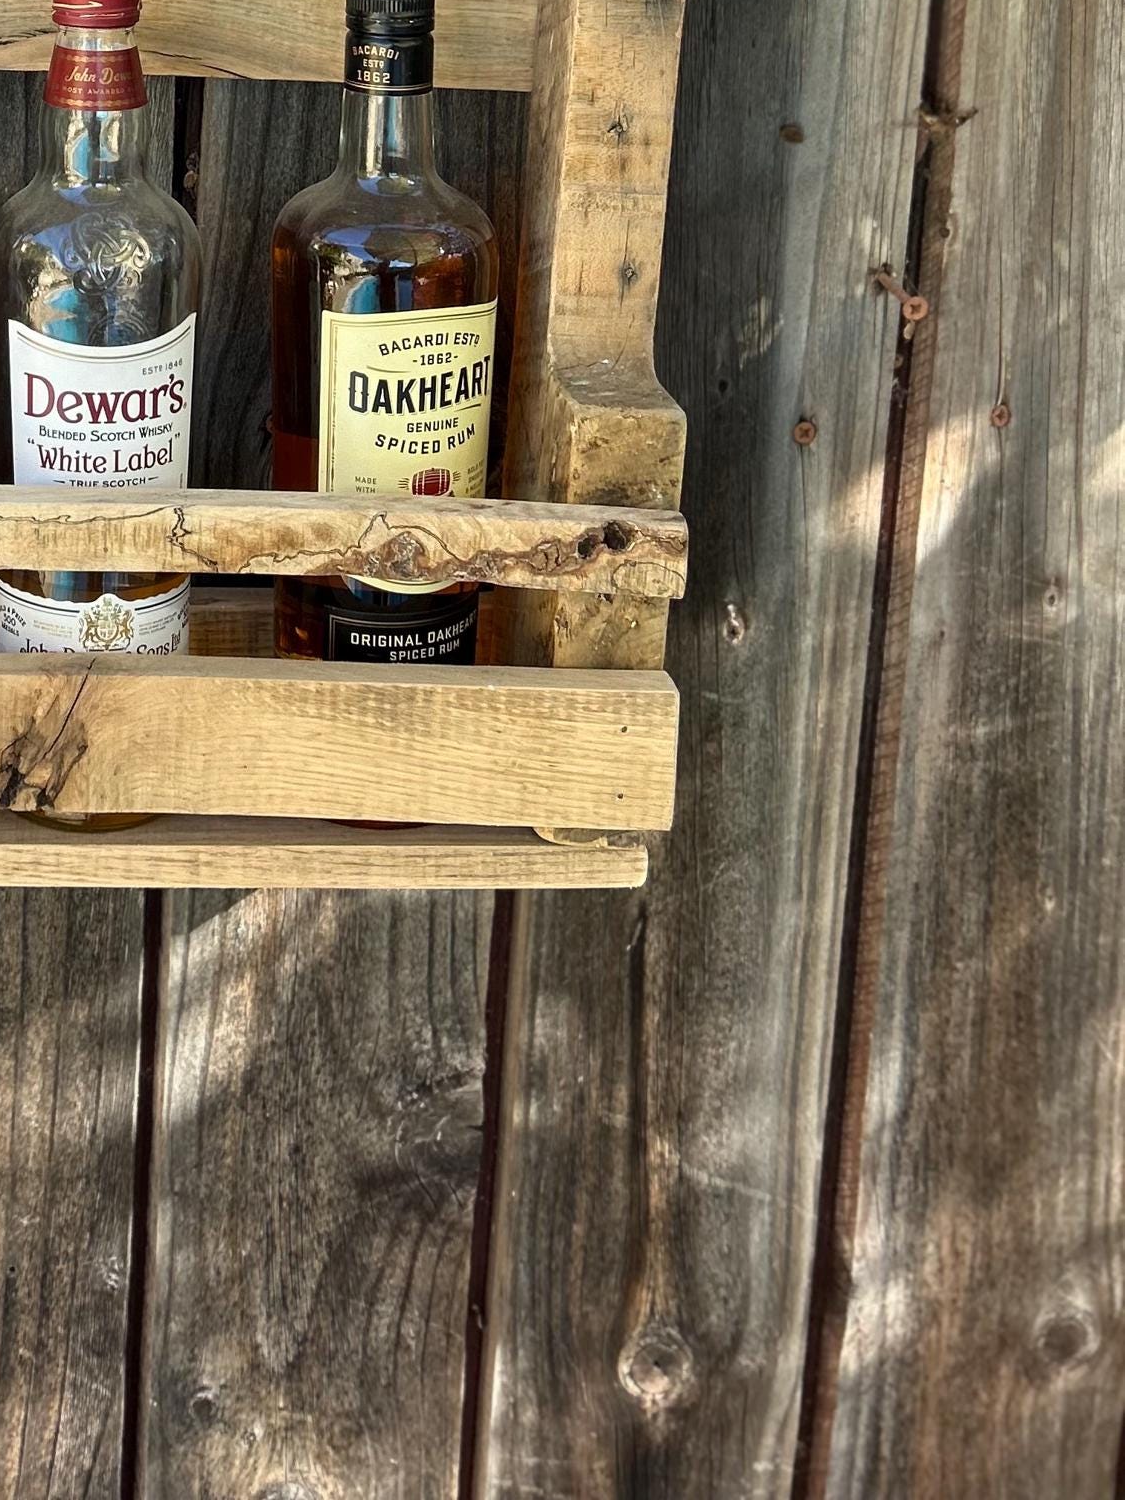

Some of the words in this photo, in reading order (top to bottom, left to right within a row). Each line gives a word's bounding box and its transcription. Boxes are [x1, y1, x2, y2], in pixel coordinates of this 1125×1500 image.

[352, 45, 400, 61] BACARDI
[64, 65, 96, 83] John
[98, 66, 132, 85] Dew
[357, 70, 391, 84] 1862
[378, 332, 449, 357] BACARDI
[165, 357, 183, 371] 1846
[348, 355, 491, 415] OAKHEART
[23, 372, 185, 425] Dewar's
[406, 417, 460, 434] GENUINE
[375, 434, 440, 455] SPICED
[447, 423, 476, 450] RUM
[69, 479, 100, 488] TRUE
[102, 476, 147, 488] SCOTCH
[354, 476, 377, 485] MADE
[355, 485, 376, 494] WITH
[11, 607, 27, 627] PRIZE
[350, 632, 423, 648] ORIGINAL
[389, 647, 435, 662] SPICED
[439, 639, 460, 655] RUM
